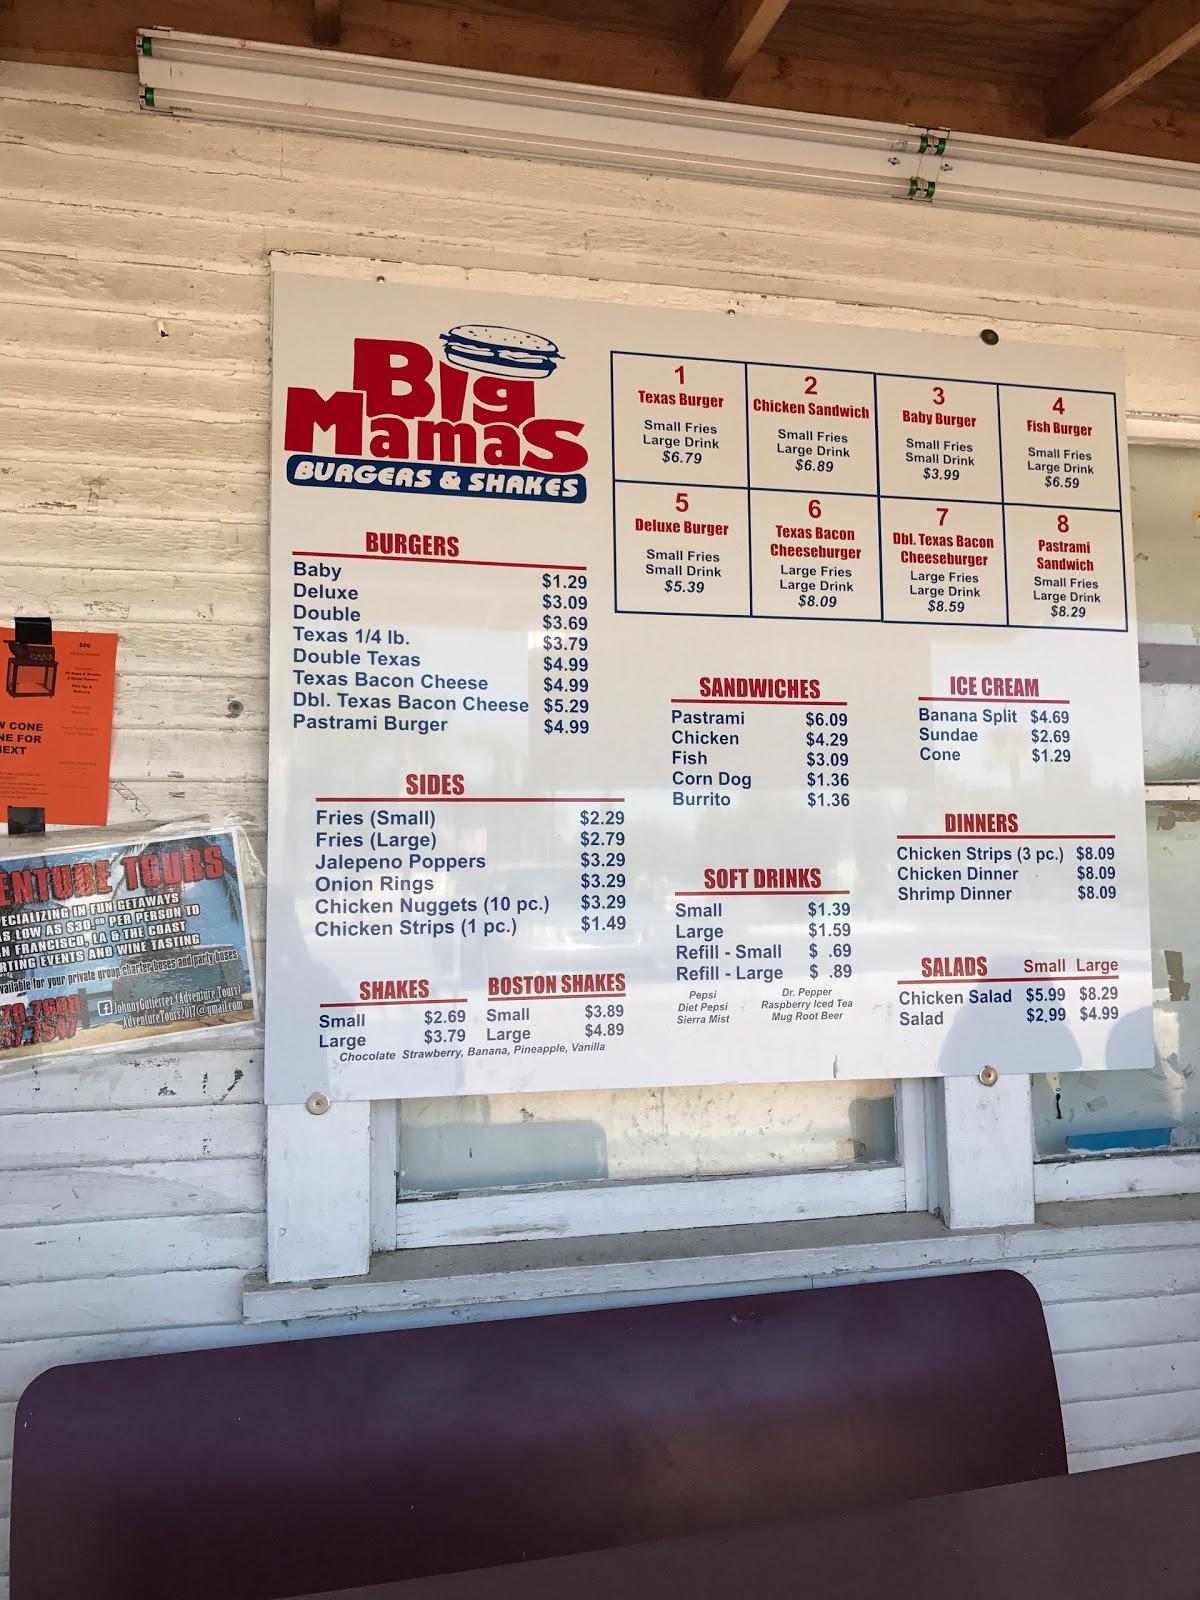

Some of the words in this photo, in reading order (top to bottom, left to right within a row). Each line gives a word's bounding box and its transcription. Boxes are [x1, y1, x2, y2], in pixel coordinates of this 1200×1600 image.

[675, 366, 686, 385] 1
[804, 375, 817, 395] 2
[638, 390, 676, 405] Texas
[679, 393, 724, 409] Burger
[932, 387, 945, 405] 3
[753, 398, 805, 415] Chicken
[808, 402, 869, 419] Sandwich
[1052, 397, 1065, 416] 4
[644, 419, 681, 432] Small
[685, 422, 717, 434] Fries
[902, 410, 933, 425] Baby
[935, 412, 977, 428] Burger
[1027, 419, 1051, 433] Fish
[1053, 421, 1093, 437] Burger
[643, 434, 680, 449] Large
[685, 436, 719, 449] Drink
[662, 450, 702, 464] $6.79
[294, 460, 432, 490] BURGERS
[439, 470, 462, 491] &
[468, 473, 579, 498] SHAKES
[675, 494, 689, 513] 5
[808, 499, 822, 519] 6
[936, 507, 949, 526] 7
[1057, 514, 1069, 533] 8
[635, 518, 681, 533] Deluxe
[684, 520, 729, 536] Burger
[775, 525, 812, 539] Texas
[815, 527, 855, 541] Bacon
[365, 531, 460, 557] BURGERS
[893, 532, 916, 546] Dbl.
[918, 533, 954, 547] Texas
[956, 535, 994, 549] Bacon
[1038, 539, 1091, 554] Pastrami
[770, 543, 862, 560] Cheeseburger
[901, 550, 988, 567] Cheeseburger
[1037, 557, 1094, 571] Sandwich
[294, 561, 342, 582] Baby
[542, 572, 587, 589] $1.29
[293, 626, 348, 643] Texas
[355, 629, 382, 644] 1/4
[388, 630, 409, 645] lb.
[543, 635, 588, 651] $3.79
[700, 677, 820, 699] SANDWICHES
[950, 676, 977, 695] ICE
[982, 677, 1039, 697] CREAM
[293, 691, 330, 707] Dbl.
[336, 692, 391, 709] Texas
[398, 694, 456, 710] Bacon
[463, 696, 529, 712] Cheese
[544, 697, 589, 714] $5.29
[672, 710, 744, 725] Pastrami
[806, 711, 848, 727] $6.09
[919, 707, 977, 722] Banana
[983, 709, 1017, 726] Split
[1031, 709, 1069, 725] $4.69
[9, 722, 43, 732] CONE
[17, 734, 42, 744] FOR
[920, 747, 960, 761] Cone
[1032, 748, 1071, 763] $1.29
[406, 774, 464, 795] SIDES
[945, 813, 1018, 833] DINNERS
[315, 854, 402, 873] Jalepeno
[409, 854, 486, 872] Poppers
[580, 851, 625, 869] $3.29
[897, 846, 961, 860] Chicken
[966, 846, 1012, 864] Strips
[1017, 846, 1031, 864] (3
[1036, 847, 1064, 864] pc.)
[1076, 846, 1115, 861] $8.09
[122, 846, 224, 891] TOURS
[704, 868, 749, 889] SOFT
[754, 868, 821, 888] DRINKS
[0, 906, 69, 928] ECIALIZING
[73, 904, 87, 917] IN
[90, 900, 114, 916] FUN
[117, 892, 180, 912] GETAWAYS
[315, 898, 393, 914] Chicken
[400, 898, 477, 916] Nuggets
[484, 896, 510, 915] (10
[517, 895, 549, 915] pc.)
[581, 894, 626, 911] $3.29
[676, 903, 722, 917] Small
[808, 901, 850, 918] $1.39
[15, 928, 41, 942] LOW
[46, 923, 62, 937] AS
[108, 914, 132, 927] PER
[136, 906, 181, 923] PERSON
[185, 904, 200, 917] TO
[93, 931, 107, 945] LA
[111, 929, 121, 942] &
[123, 926, 144, 940] THE
[149, 920, 186, 937] COAST
[40, 951, 84, 969] EVENTS
[88, 946, 113, 961] AND
[117, 940, 148, 956] WINE
[151, 934, 200, 951] TASTING
[33, 975, 46, 989] for
[47, 973, 66, 990] your
[67, 969, 96, 987] private
[97, 965, 121, 983] group
[122, 960, 152, 977] charter
[153, 956, 176, 971] buses
[178, 954, 193, 968] and
[193, 951, 215, 967] party
[216, 949, 238, 965] buses
[921, 956, 988, 977] SALADS
[1024, 959, 1065, 973] Small
[1077, 958, 1118, 974] Large
[360, 979, 429, 1000] SHAKES
[488, 975, 556, 995] BOSTON
[561, 973, 625, 993] SHAKES
[782, 988, 794, 996] Dr.
[798, 988, 832, 998] Pepper
[689, 990, 717, 1001] Pepsi
[761, 1000, 811, 1010] Raspberry
[814, 1000, 834, 1008] Iced
[837, 999, 853, 1007] Tea
[899, 991, 963, 1005] Chicken
[969, 988, 1012, 1004] Salad
[1026, 987, 1065, 1004] $5.99
[1080, 986, 1118, 1002] $8.29
[678, 1003, 698, 1012] Diet
[701, 1003, 728, 1013] Pepsi
[772, 1012, 792, 1023] Mug
[796, 1012, 818, 1020] Root
[821, 1011, 843, 1019] Beer
[319, 1013, 365, 1029] Small
[424, 1010, 466, 1026] $2.69
[677, 1015, 706, 1024] Sierra
[709, 1015, 730, 1023] Mist
[487, 1028, 531, 1043] Large
[585, 1023, 624, 1038] $4.89
[340, 1051, 396, 1062] Chocolate
[402, 1049, 463, 1059] Strawberry,
[467, 1047, 510, 1056] Banana,
[514, 1044, 567, 1055] Pineapple,
[572, 1042, 605, 1052] Vanilla
